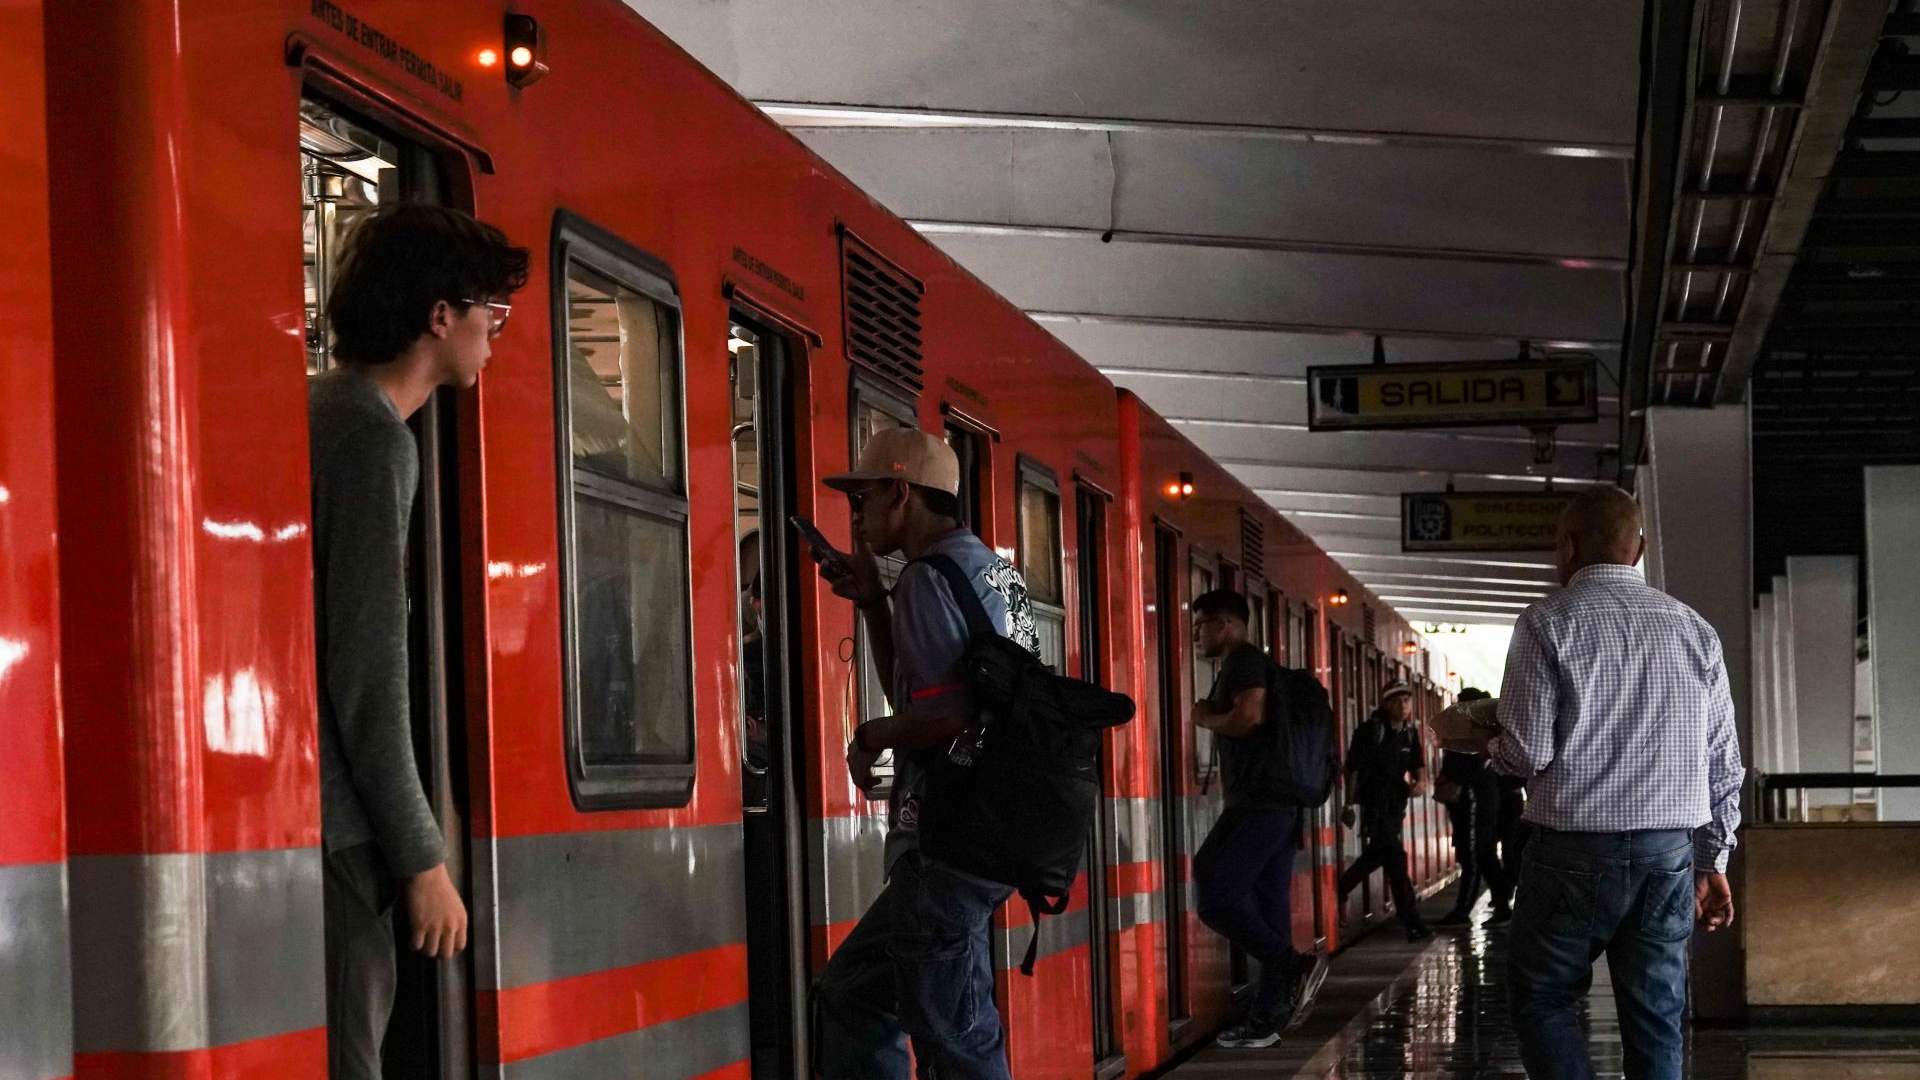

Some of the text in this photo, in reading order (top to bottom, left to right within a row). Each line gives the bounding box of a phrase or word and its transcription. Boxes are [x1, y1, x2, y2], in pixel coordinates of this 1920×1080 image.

[311, 0, 343, 32] ANTES
[345, 13, 358, 42] DE
[361, 22, 399, 62] ENTRAR
[1380, 378, 1525, 406] SALIDA
